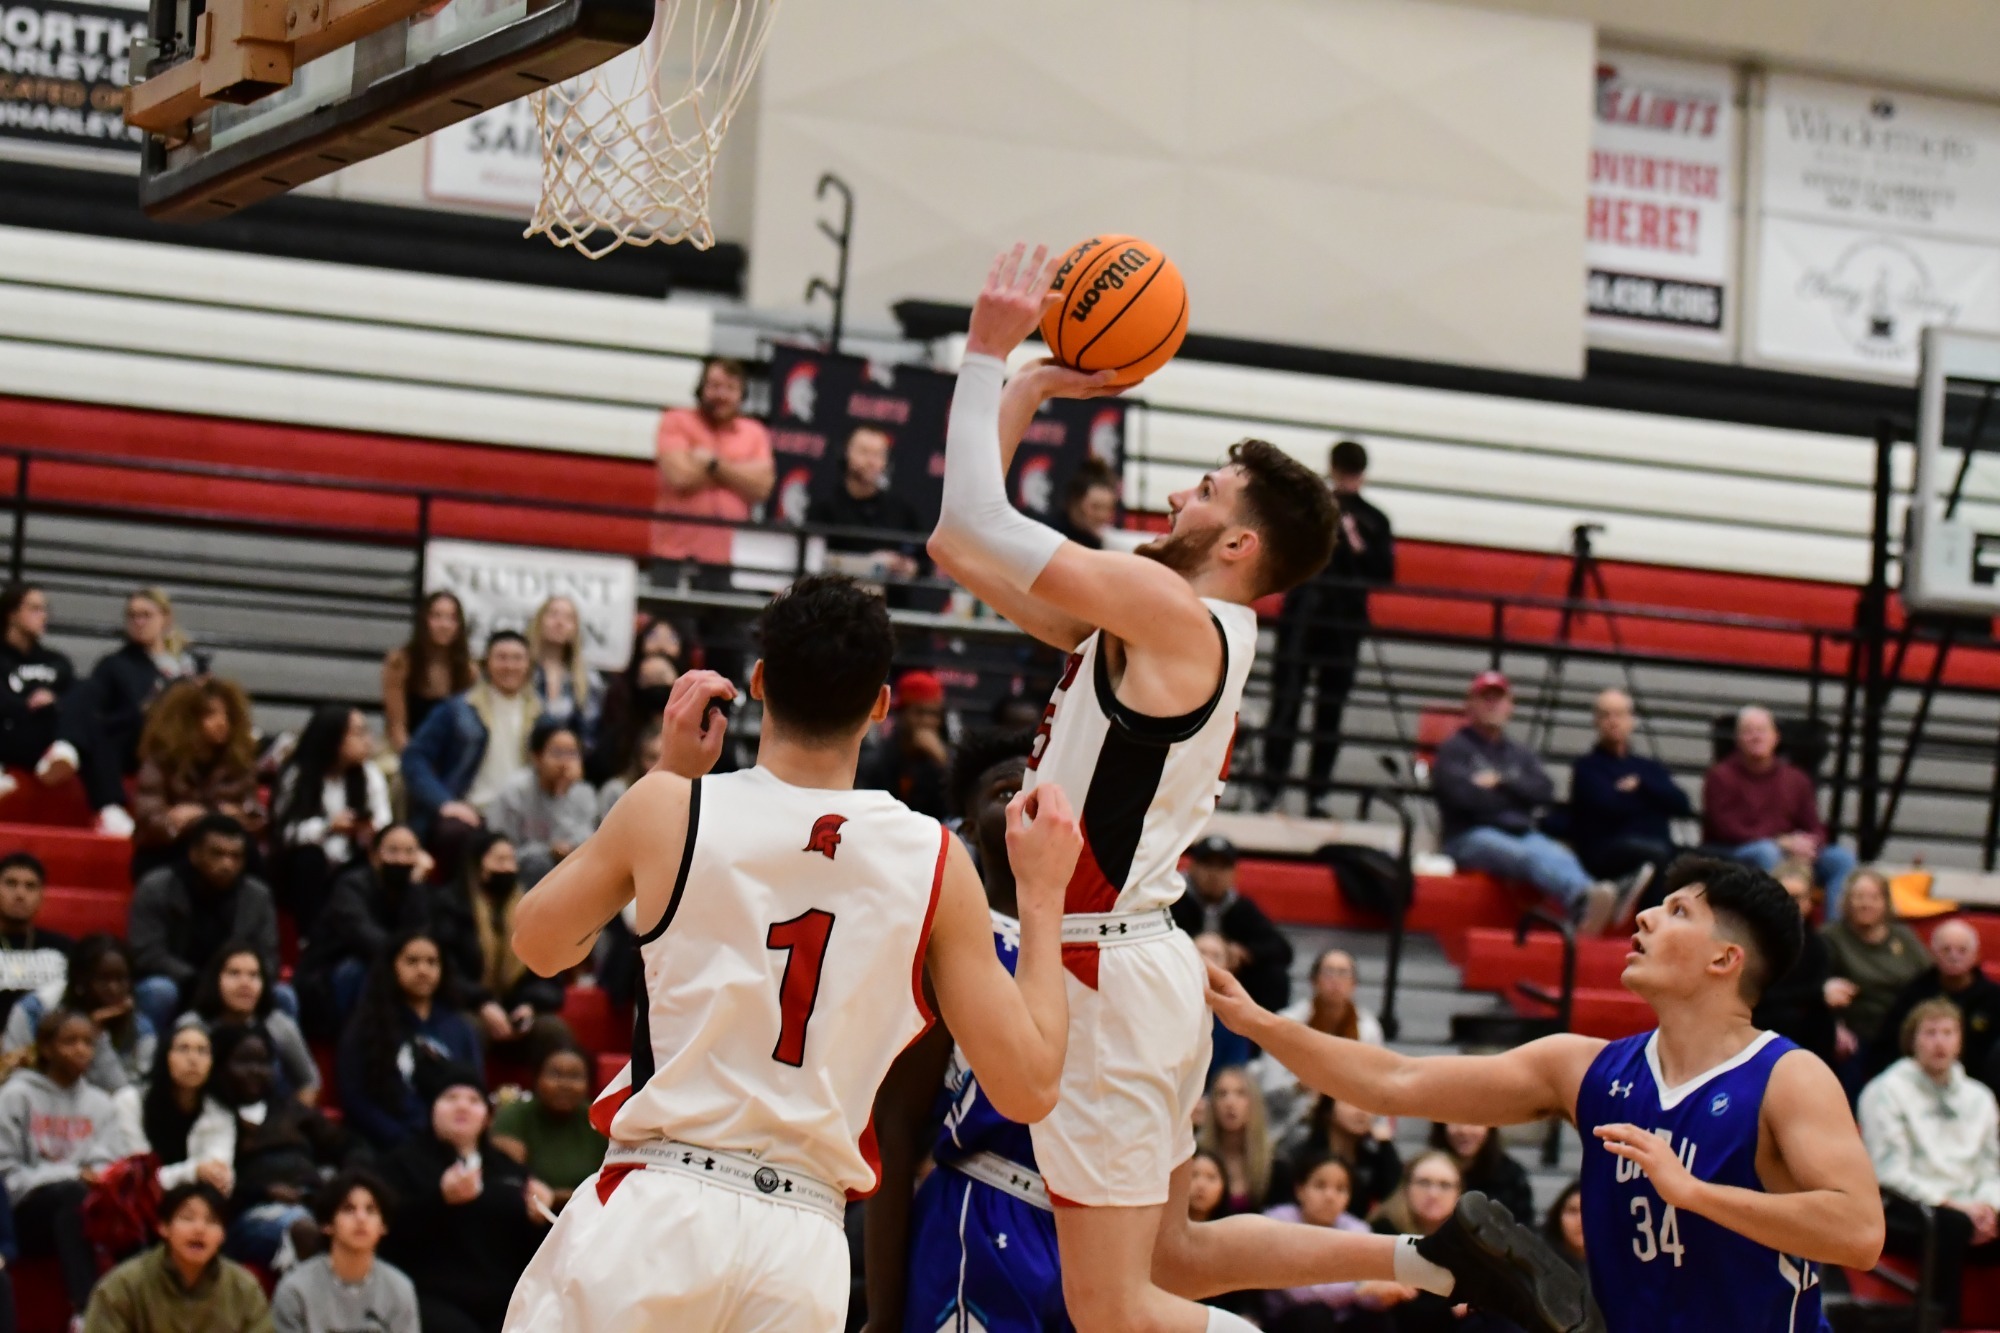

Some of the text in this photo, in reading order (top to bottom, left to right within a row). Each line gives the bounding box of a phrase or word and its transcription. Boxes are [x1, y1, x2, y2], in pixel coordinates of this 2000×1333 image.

[0, 6, 147, 57] ORTH
[1587, 195, 1698, 256] HERE!
[1070, 248, 1151, 323] Wilson
[766, 907, 836, 1068] 1
[1630, 1196, 1685, 1268] 34
